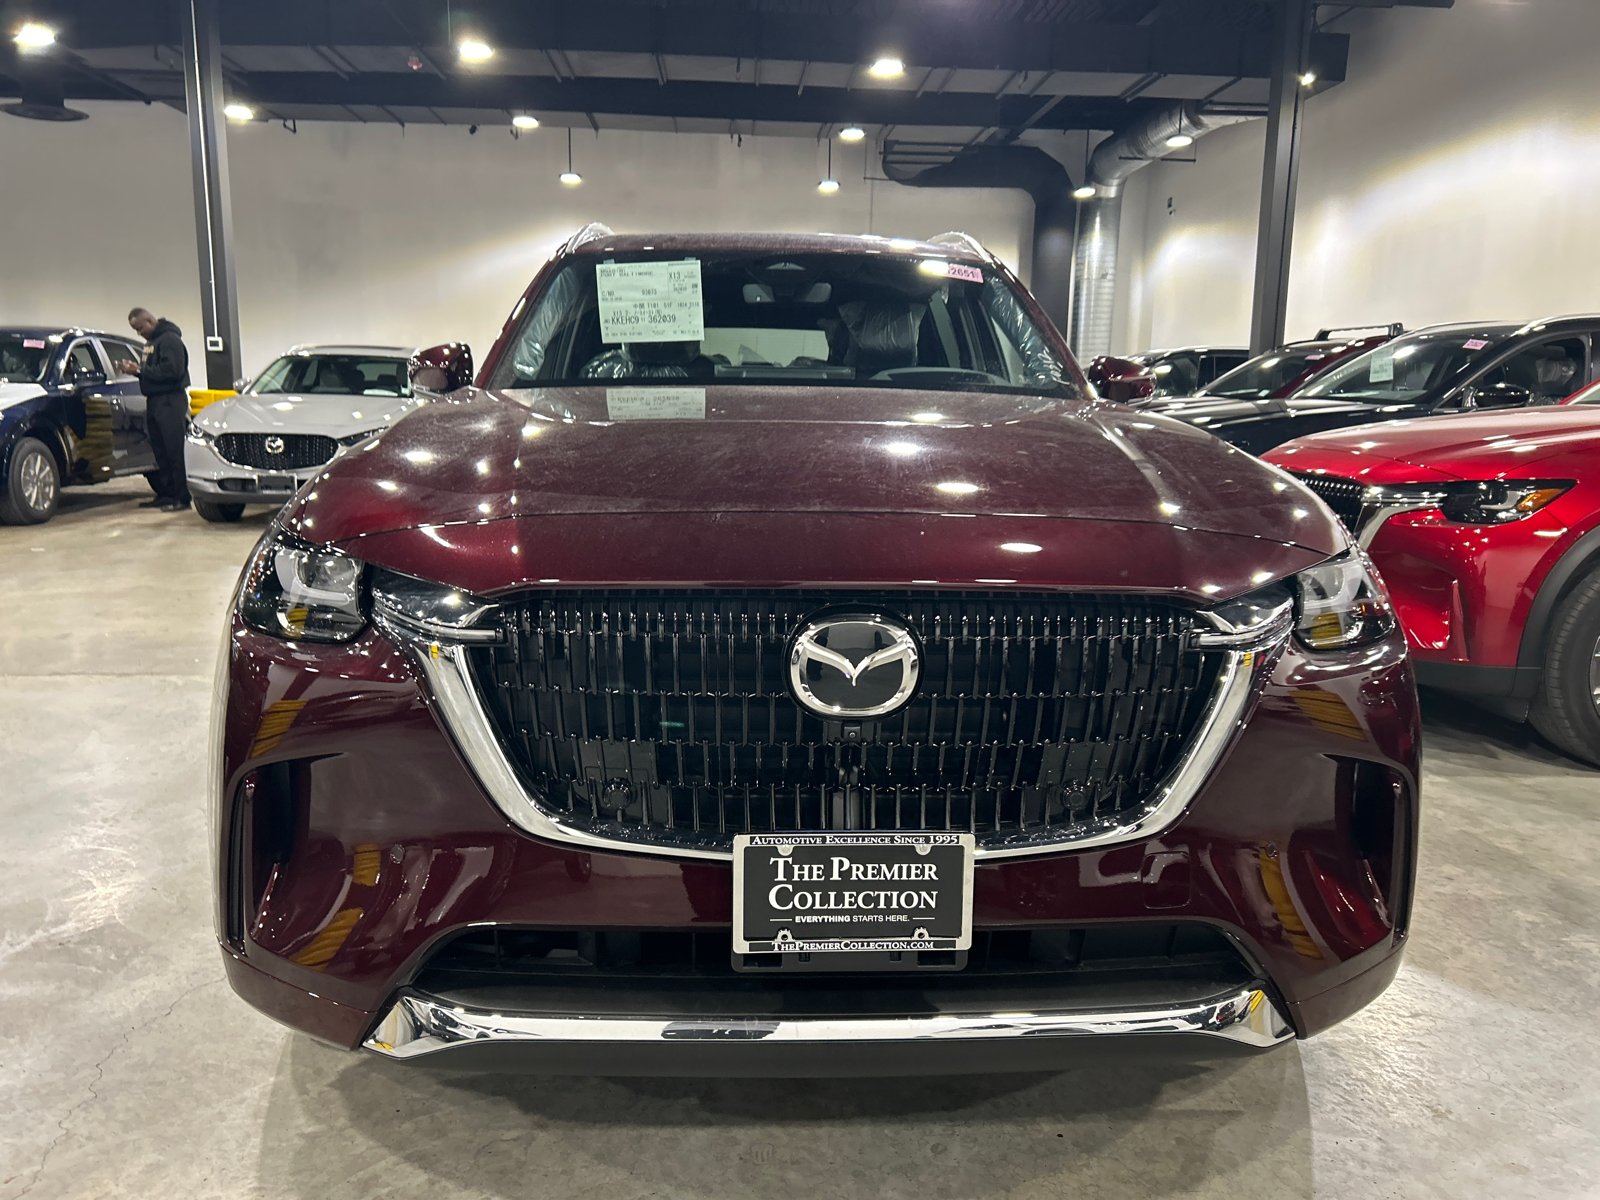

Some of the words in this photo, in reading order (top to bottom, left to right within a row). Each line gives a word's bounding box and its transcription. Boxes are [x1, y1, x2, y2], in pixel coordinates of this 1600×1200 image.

[668, 272, 681, 280] X13
[648, 314, 676, 324] 362039
[752, 836, 823, 845] AUTOMOTIVE
[825, 835, 891, 844] EXCELLENCE
[893, 835, 926, 844] SINCE
[929, 835, 958, 844] 1995
[769, 856, 825, 881] THE
[829, 856, 939, 881] PREMIER
[768, 883, 939, 911] COLLECTION
[795, 915, 851, 923] EVERYTHING
[885, 914, 910, 922] HERE.
